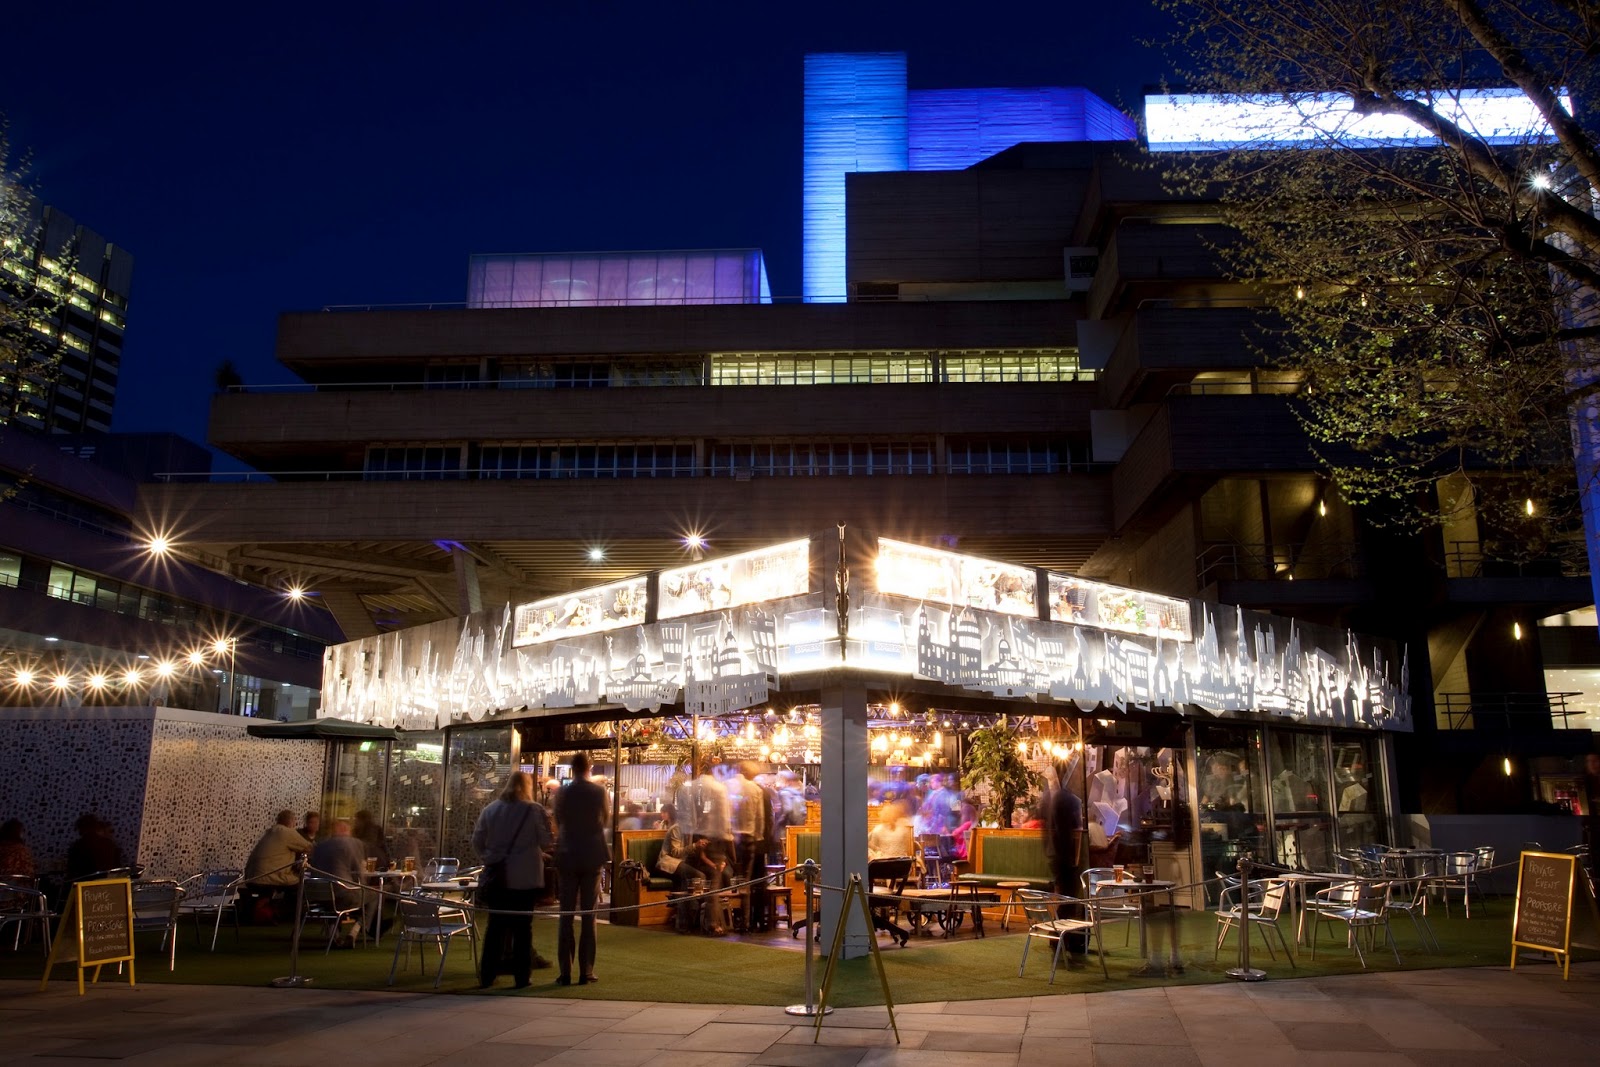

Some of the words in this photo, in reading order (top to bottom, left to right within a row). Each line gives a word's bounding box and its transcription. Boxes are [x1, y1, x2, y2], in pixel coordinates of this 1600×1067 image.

[1529, 861, 1555, 876] PRIVATE
[1535, 877, 1560, 889] EVENT
[84, 890, 110, 902] PRIVATE
[92, 902, 115, 913] EVENT
[1527, 897, 1562, 912] PROPSTORE
[87, 919, 124, 932] PROPSTORE
